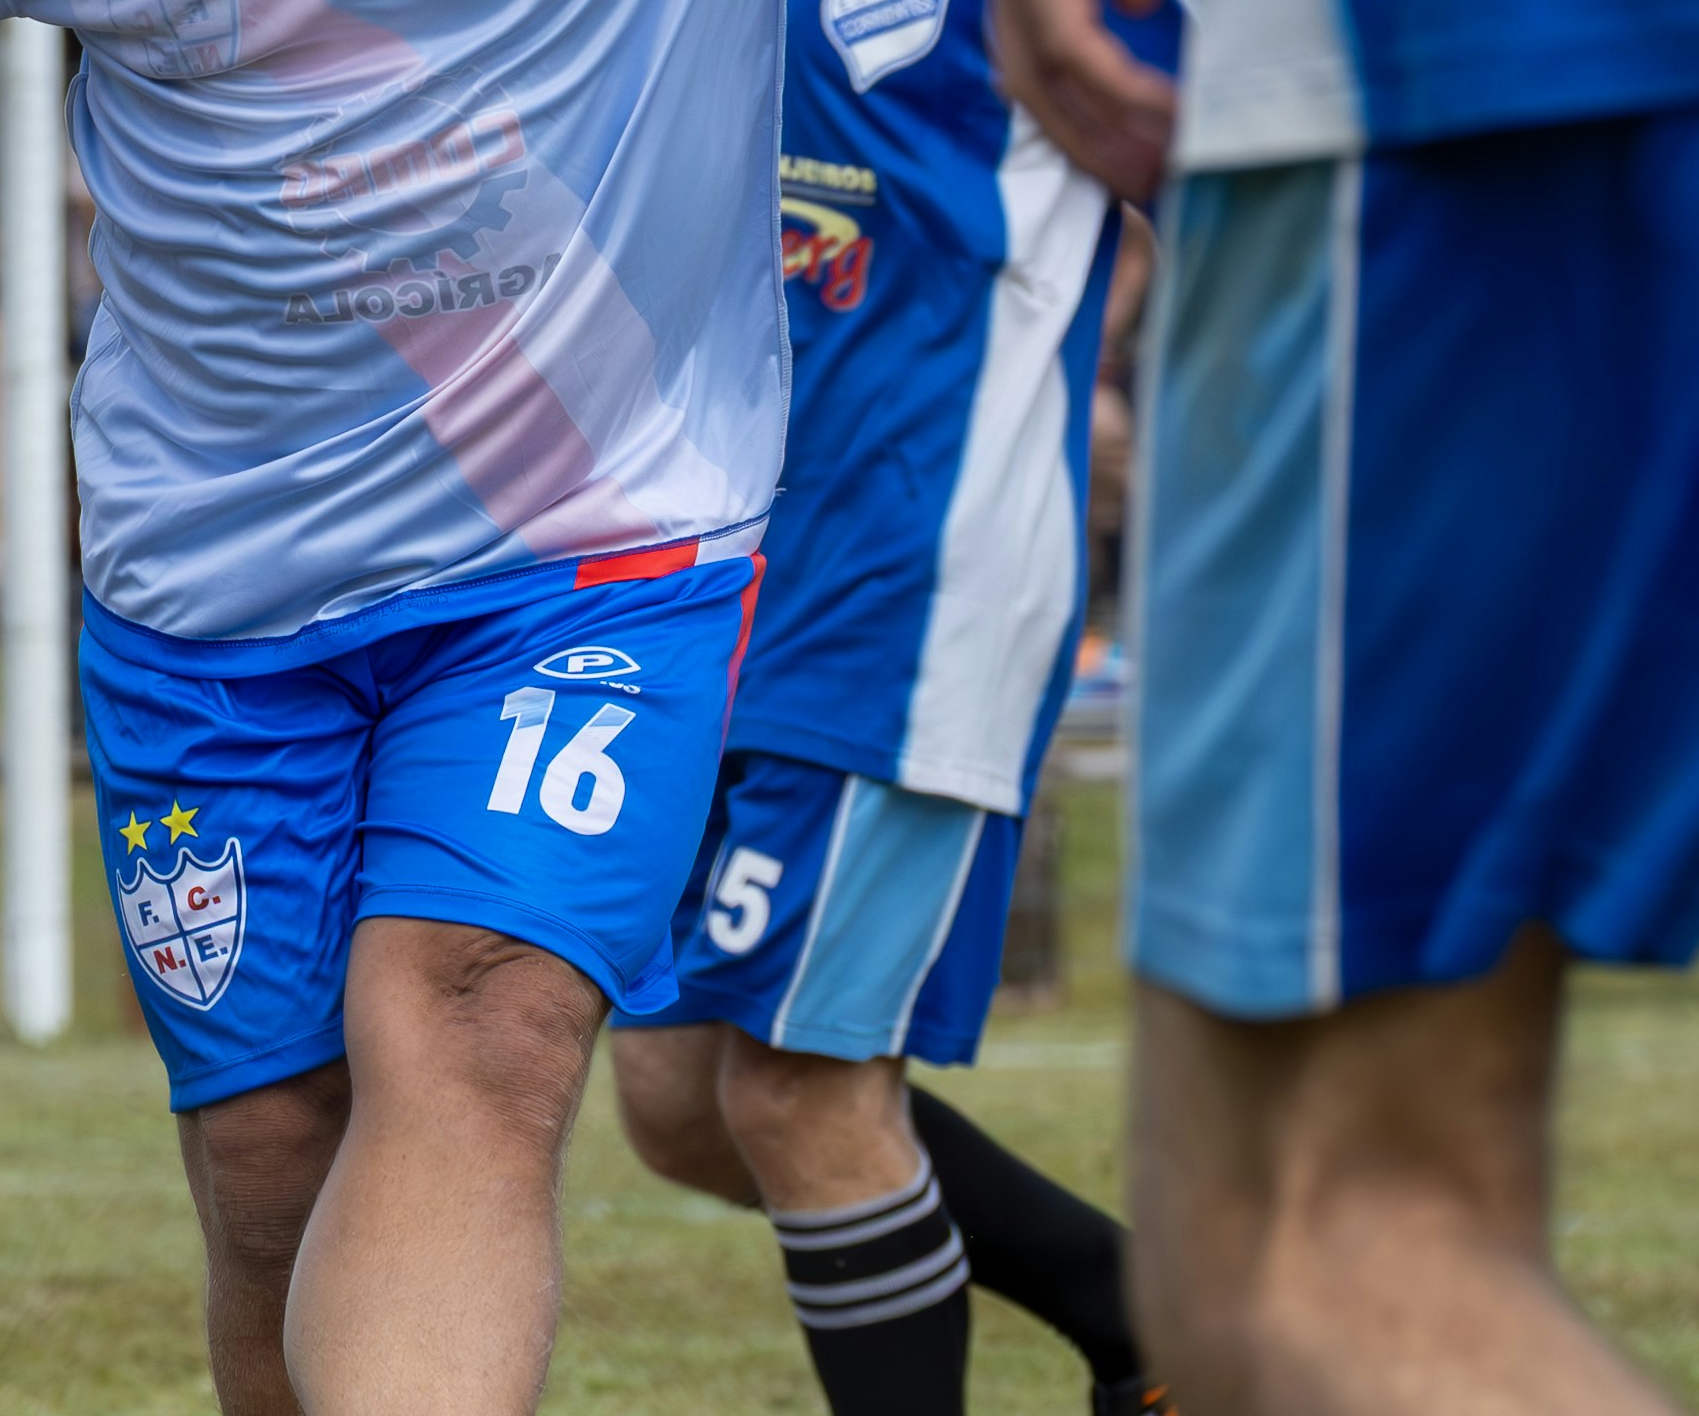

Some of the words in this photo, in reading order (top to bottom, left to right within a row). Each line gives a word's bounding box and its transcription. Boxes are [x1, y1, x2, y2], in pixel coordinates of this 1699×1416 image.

[567, 654, 614, 673] P
[486, 686, 637, 836] 16
[138, 900, 160, 927] F.
[187, 886, 221, 911] C.
[707, 846, 784, 955] 5
[153, 946, 187, 974] N.
[194, 934, 229, 963] E.
